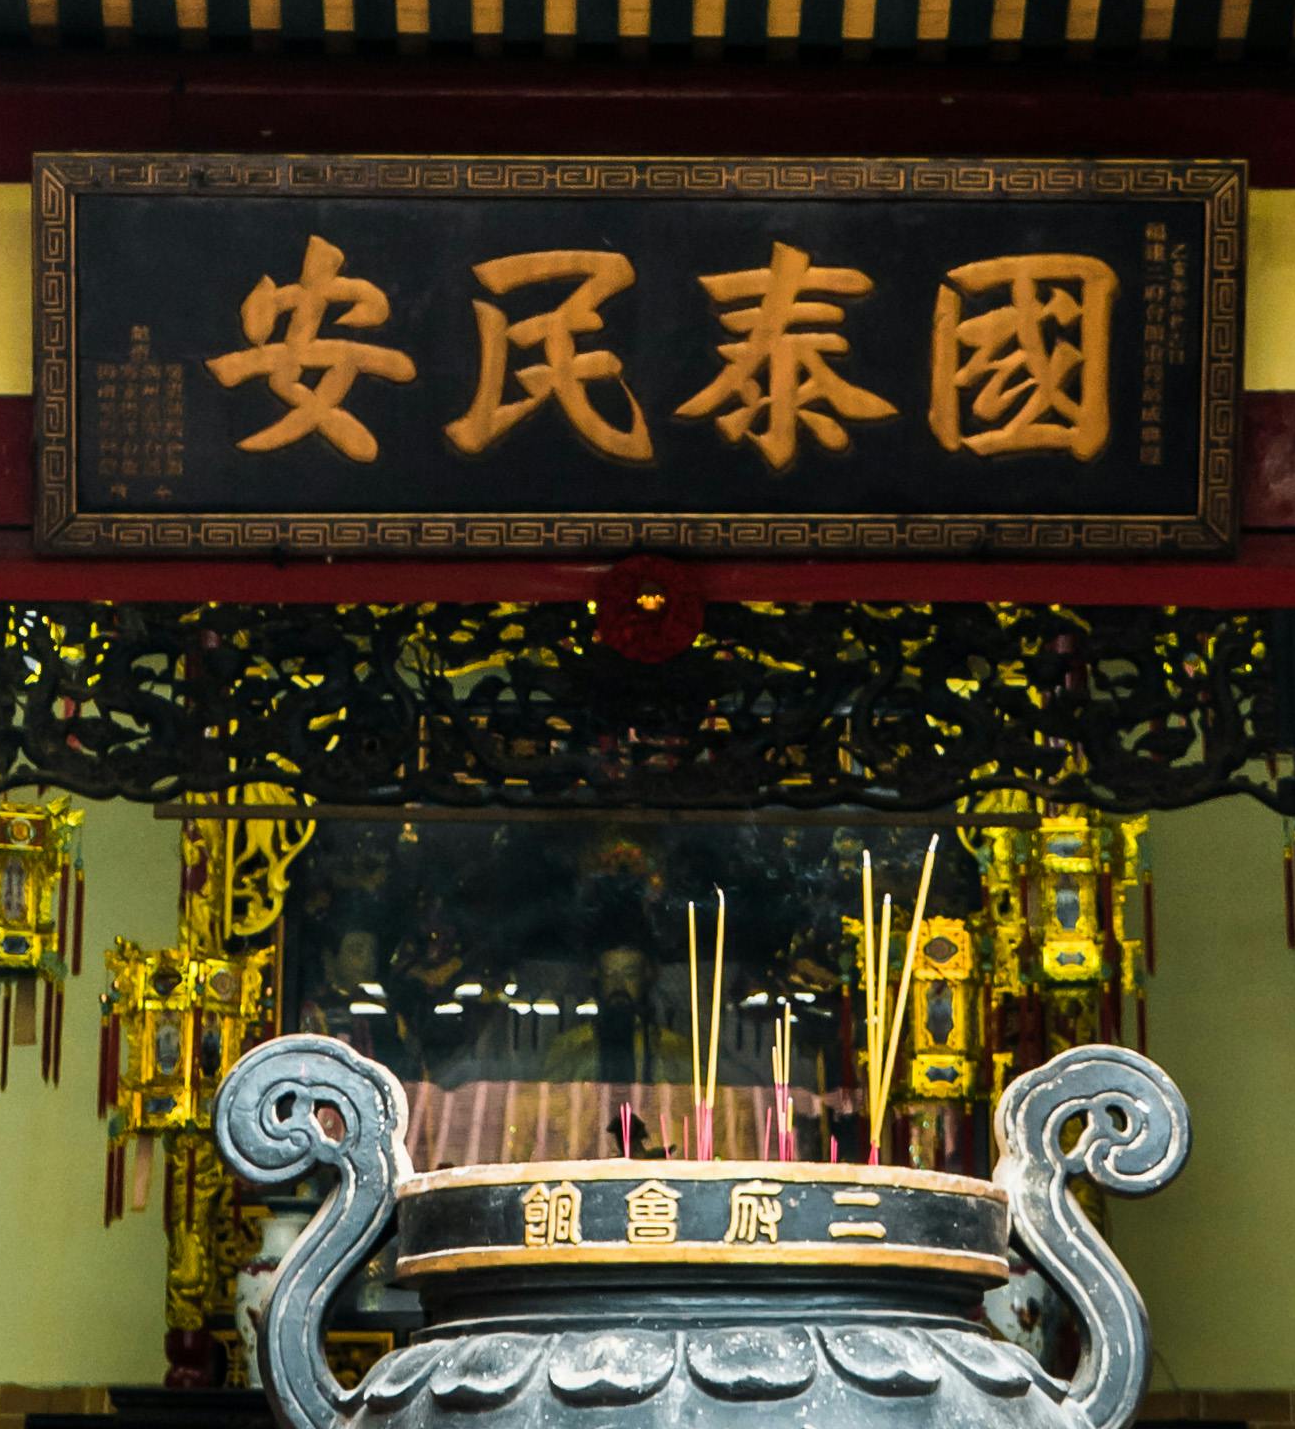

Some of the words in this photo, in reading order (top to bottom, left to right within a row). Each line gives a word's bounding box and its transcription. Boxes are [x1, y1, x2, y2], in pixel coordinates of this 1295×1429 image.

[203, 233, 1120, 471] 國泰民安
[520, 1179, 888, 1247] 二府會館
